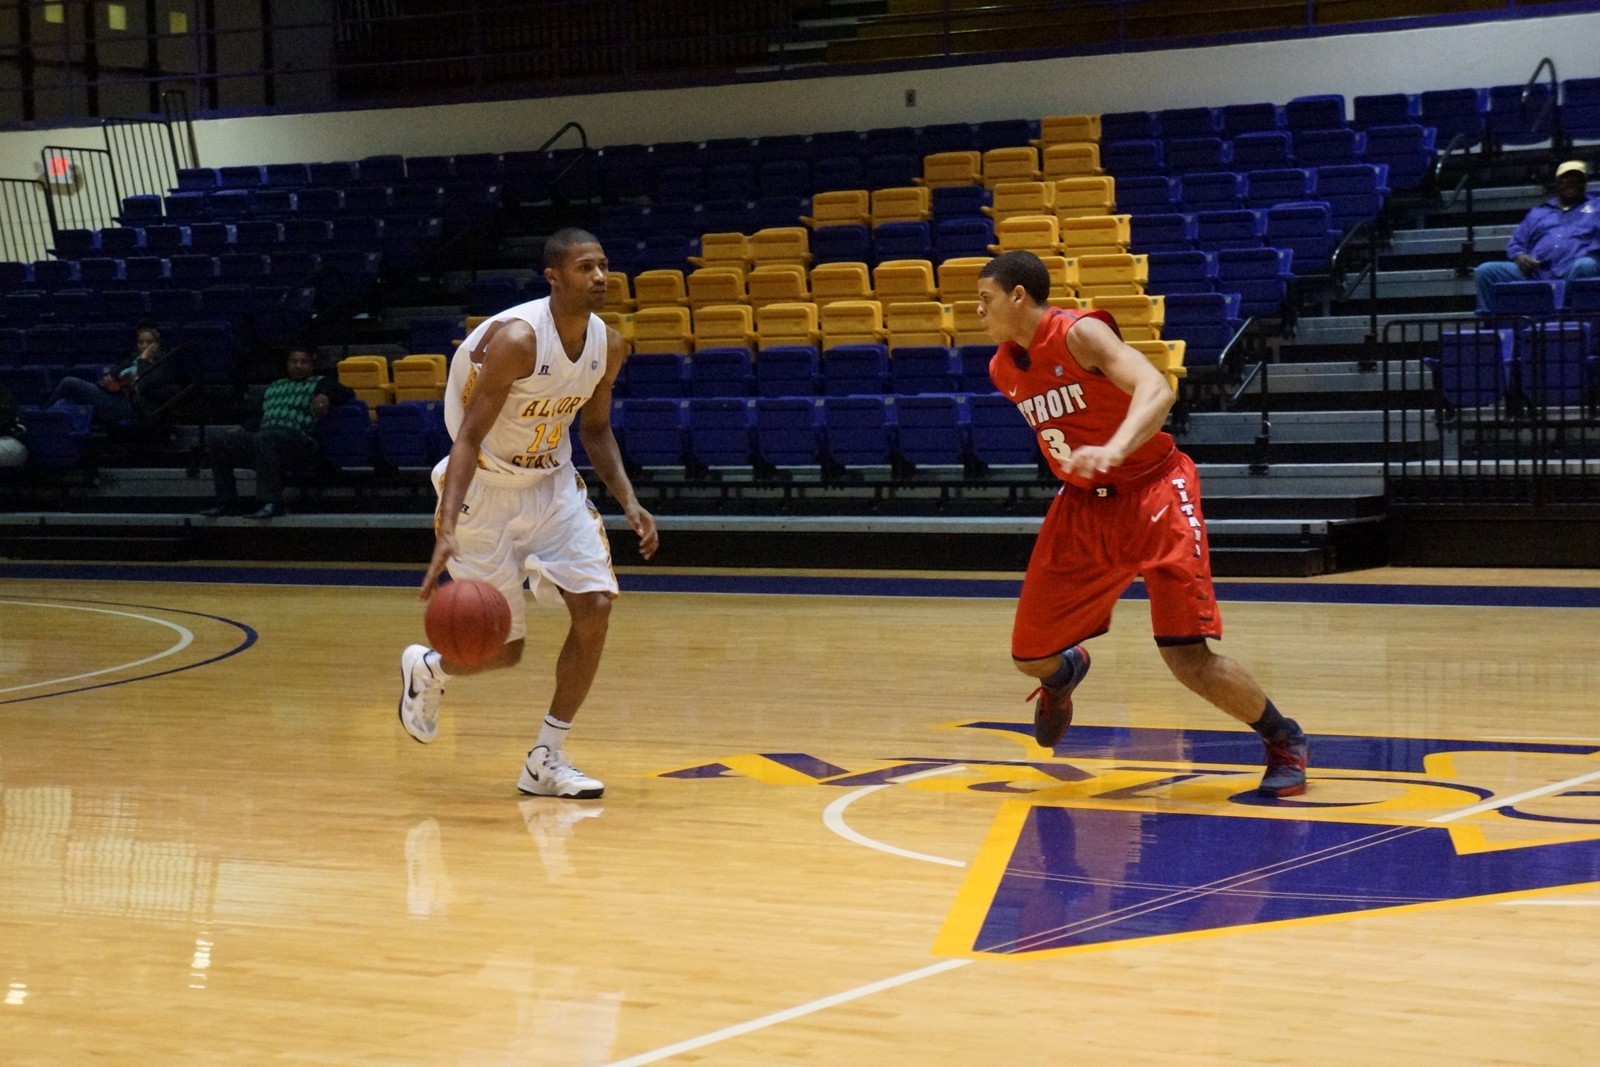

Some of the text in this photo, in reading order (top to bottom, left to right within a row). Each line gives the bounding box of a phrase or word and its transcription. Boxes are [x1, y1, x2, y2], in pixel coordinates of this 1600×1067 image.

[522, 396, 588, 417] ALOR
[1017, 383, 1087, 427] TROIT
[526, 423, 563, 453] 14
[1040, 428, 1071, 461] 3
